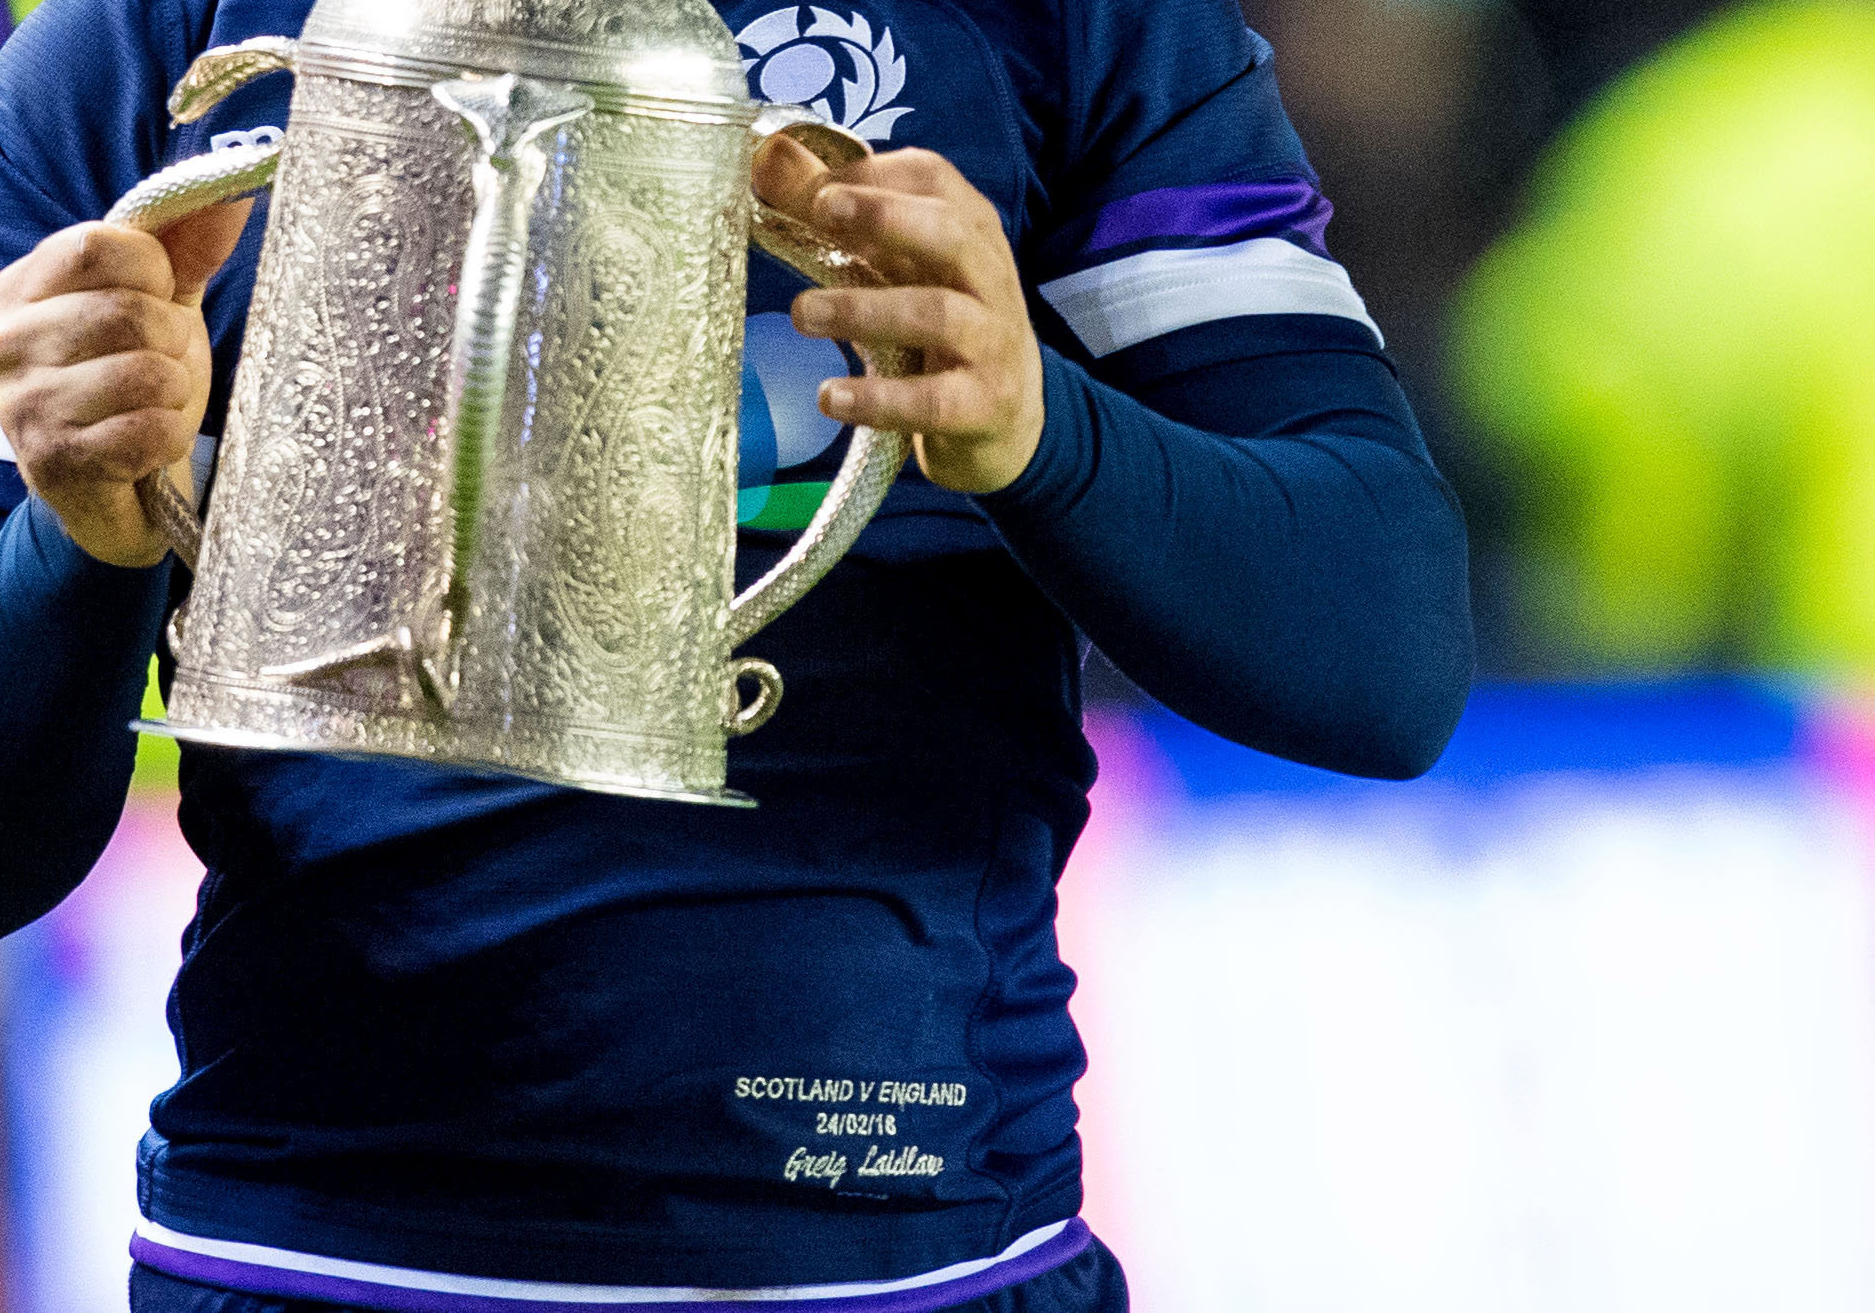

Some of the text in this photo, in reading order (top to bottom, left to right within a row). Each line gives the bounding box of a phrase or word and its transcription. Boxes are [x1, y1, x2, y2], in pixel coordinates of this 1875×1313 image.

[735, 1077, 966, 1106] SCOTLAND V ENGLAND
[816, 1112, 897, 1135] 24/02/18
[784, 1144, 945, 1189] Greig Laidlaw
